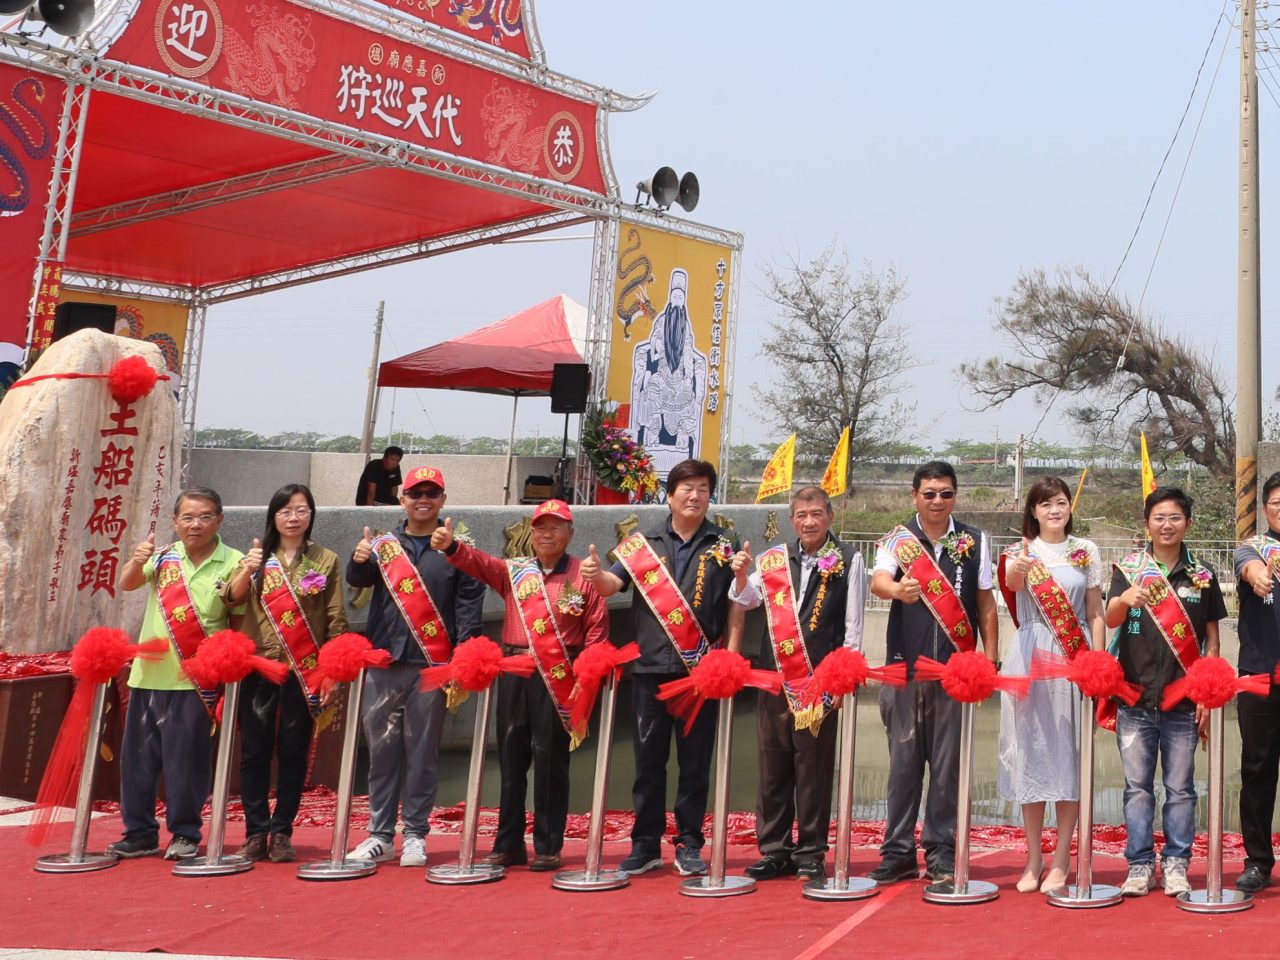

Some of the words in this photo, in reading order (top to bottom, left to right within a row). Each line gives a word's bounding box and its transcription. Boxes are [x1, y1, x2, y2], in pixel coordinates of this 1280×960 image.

[166, 4, 208, 62] 迎
[335, 64, 463, 146] 代天巡狩
[552, 126, 574, 167] 恭
[77, 398, 139, 599] 王船碼頭
